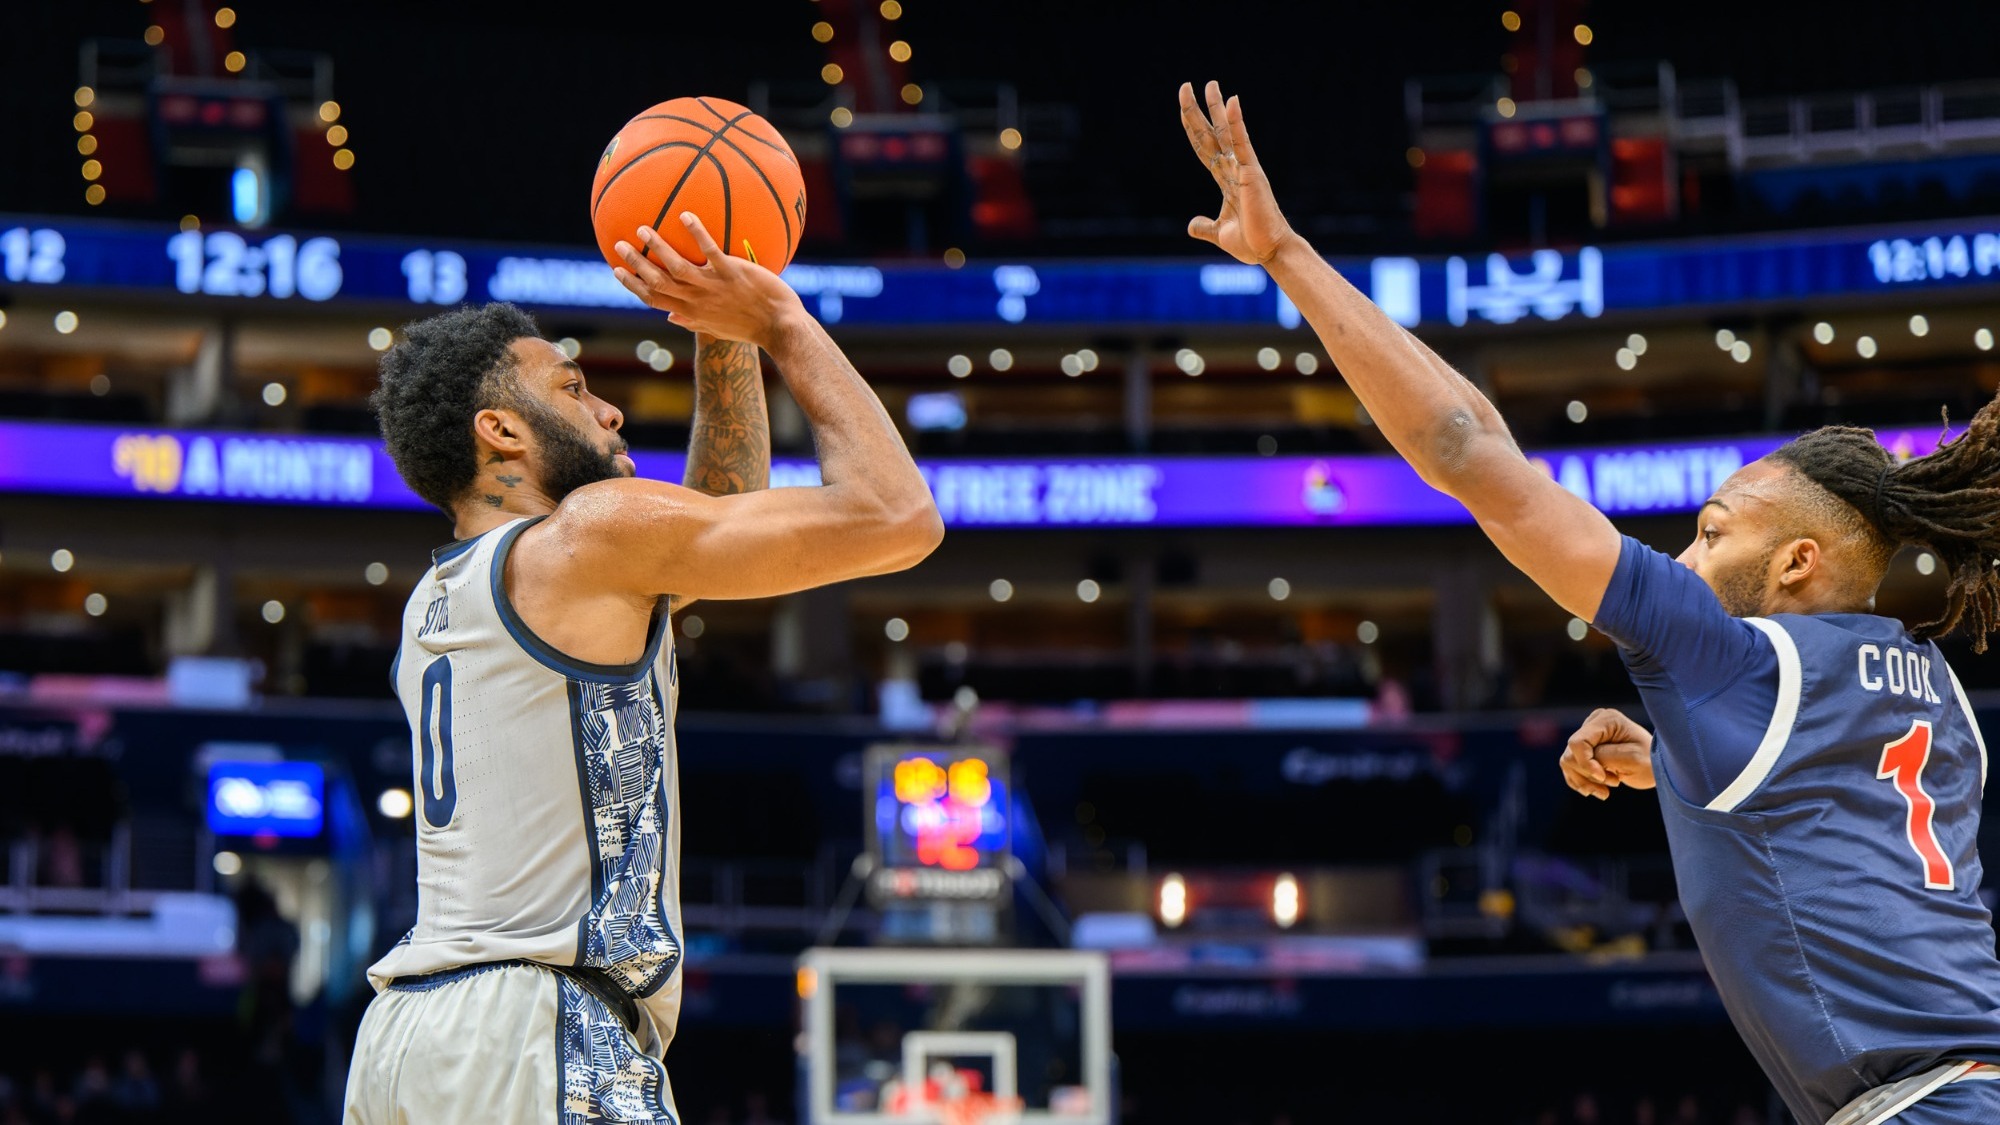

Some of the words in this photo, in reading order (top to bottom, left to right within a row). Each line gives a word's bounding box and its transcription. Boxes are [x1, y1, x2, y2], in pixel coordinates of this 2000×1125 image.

[0, 227, 66, 284] 12
[167, 230, 343, 301] 12:16
[401, 248, 468, 305] 13
[1868, 234, 1970, 283] 12:14
[1973, 232, 2000, 276] P
[183, 436, 219, 496] A
[221, 437, 373, 503] MONTH
[1559, 455, 1591, 501] A
[1858, 643, 1941, 704] COOK
[419, 653, 458, 831] 0
[1876, 719, 1955, 890] 1
